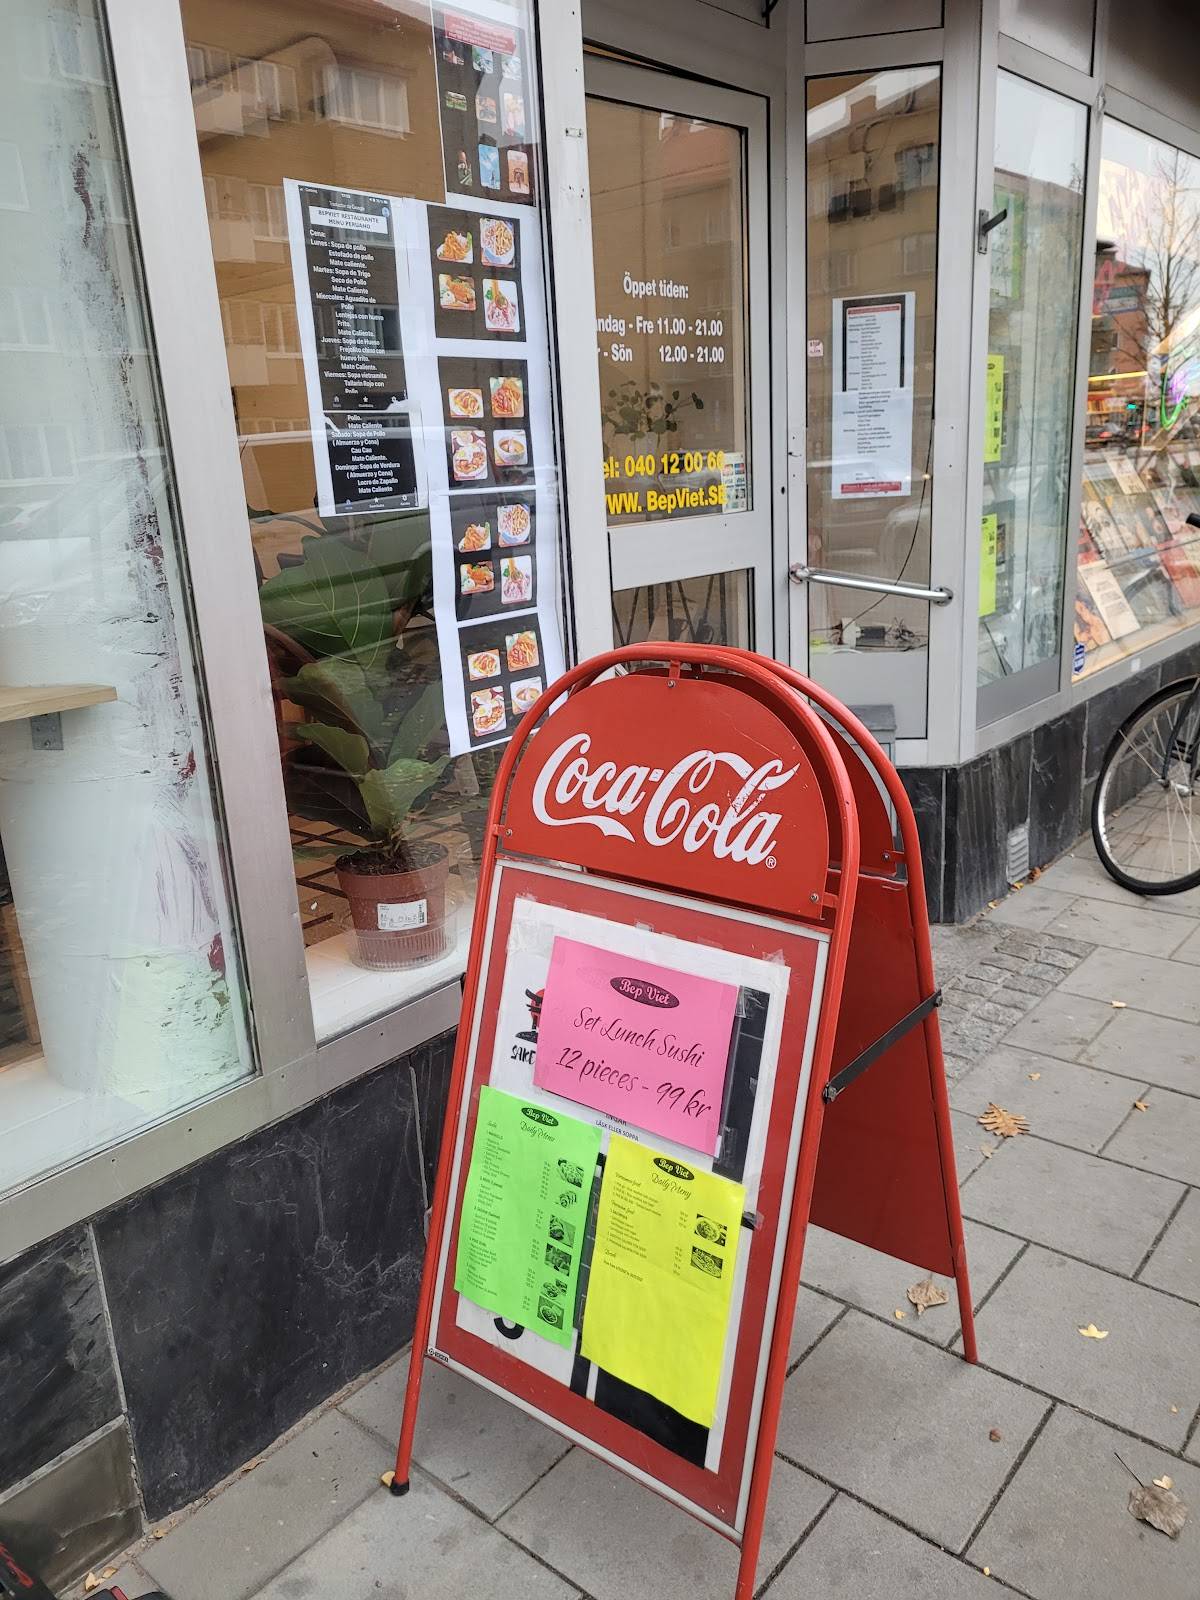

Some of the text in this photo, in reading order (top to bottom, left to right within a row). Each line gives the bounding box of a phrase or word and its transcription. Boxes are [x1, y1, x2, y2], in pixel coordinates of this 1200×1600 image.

[335, 268, 349, 276] Sopa
[357, 270, 371, 278] Trigo
[623, 272, 689, 299] Öppet tiden:
[597, 314, 626, 336] ndag
[636, 315, 654, 335] Fre
[656, 318, 685, 336] 11.00
[695, 319, 723, 337] 21.00
[611, 343, 633, 362] Sön
[659, 345, 687, 363] 12.00
[696, 346, 724, 363] 21.00
[603, 456, 620, 479] el:
[624, 454, 656, 477] 040
[661, 453, 680, 475] 12
[684, 452, 703, 473] 00
[619, 978, 671, 1006] Bep Viet
[573, 1006, 705, 1069] Set Lunch Sushi
[555, 1047, 583, 1070] 12
[580, 1059, 639, 1093] pieces
[656, 1082, 685, 1103] 99
[683, 1089, 712, 1119] kr
[658, 1158, 690, 1178] Bep Viet
[651, 1172, 670, 1191] Daily
